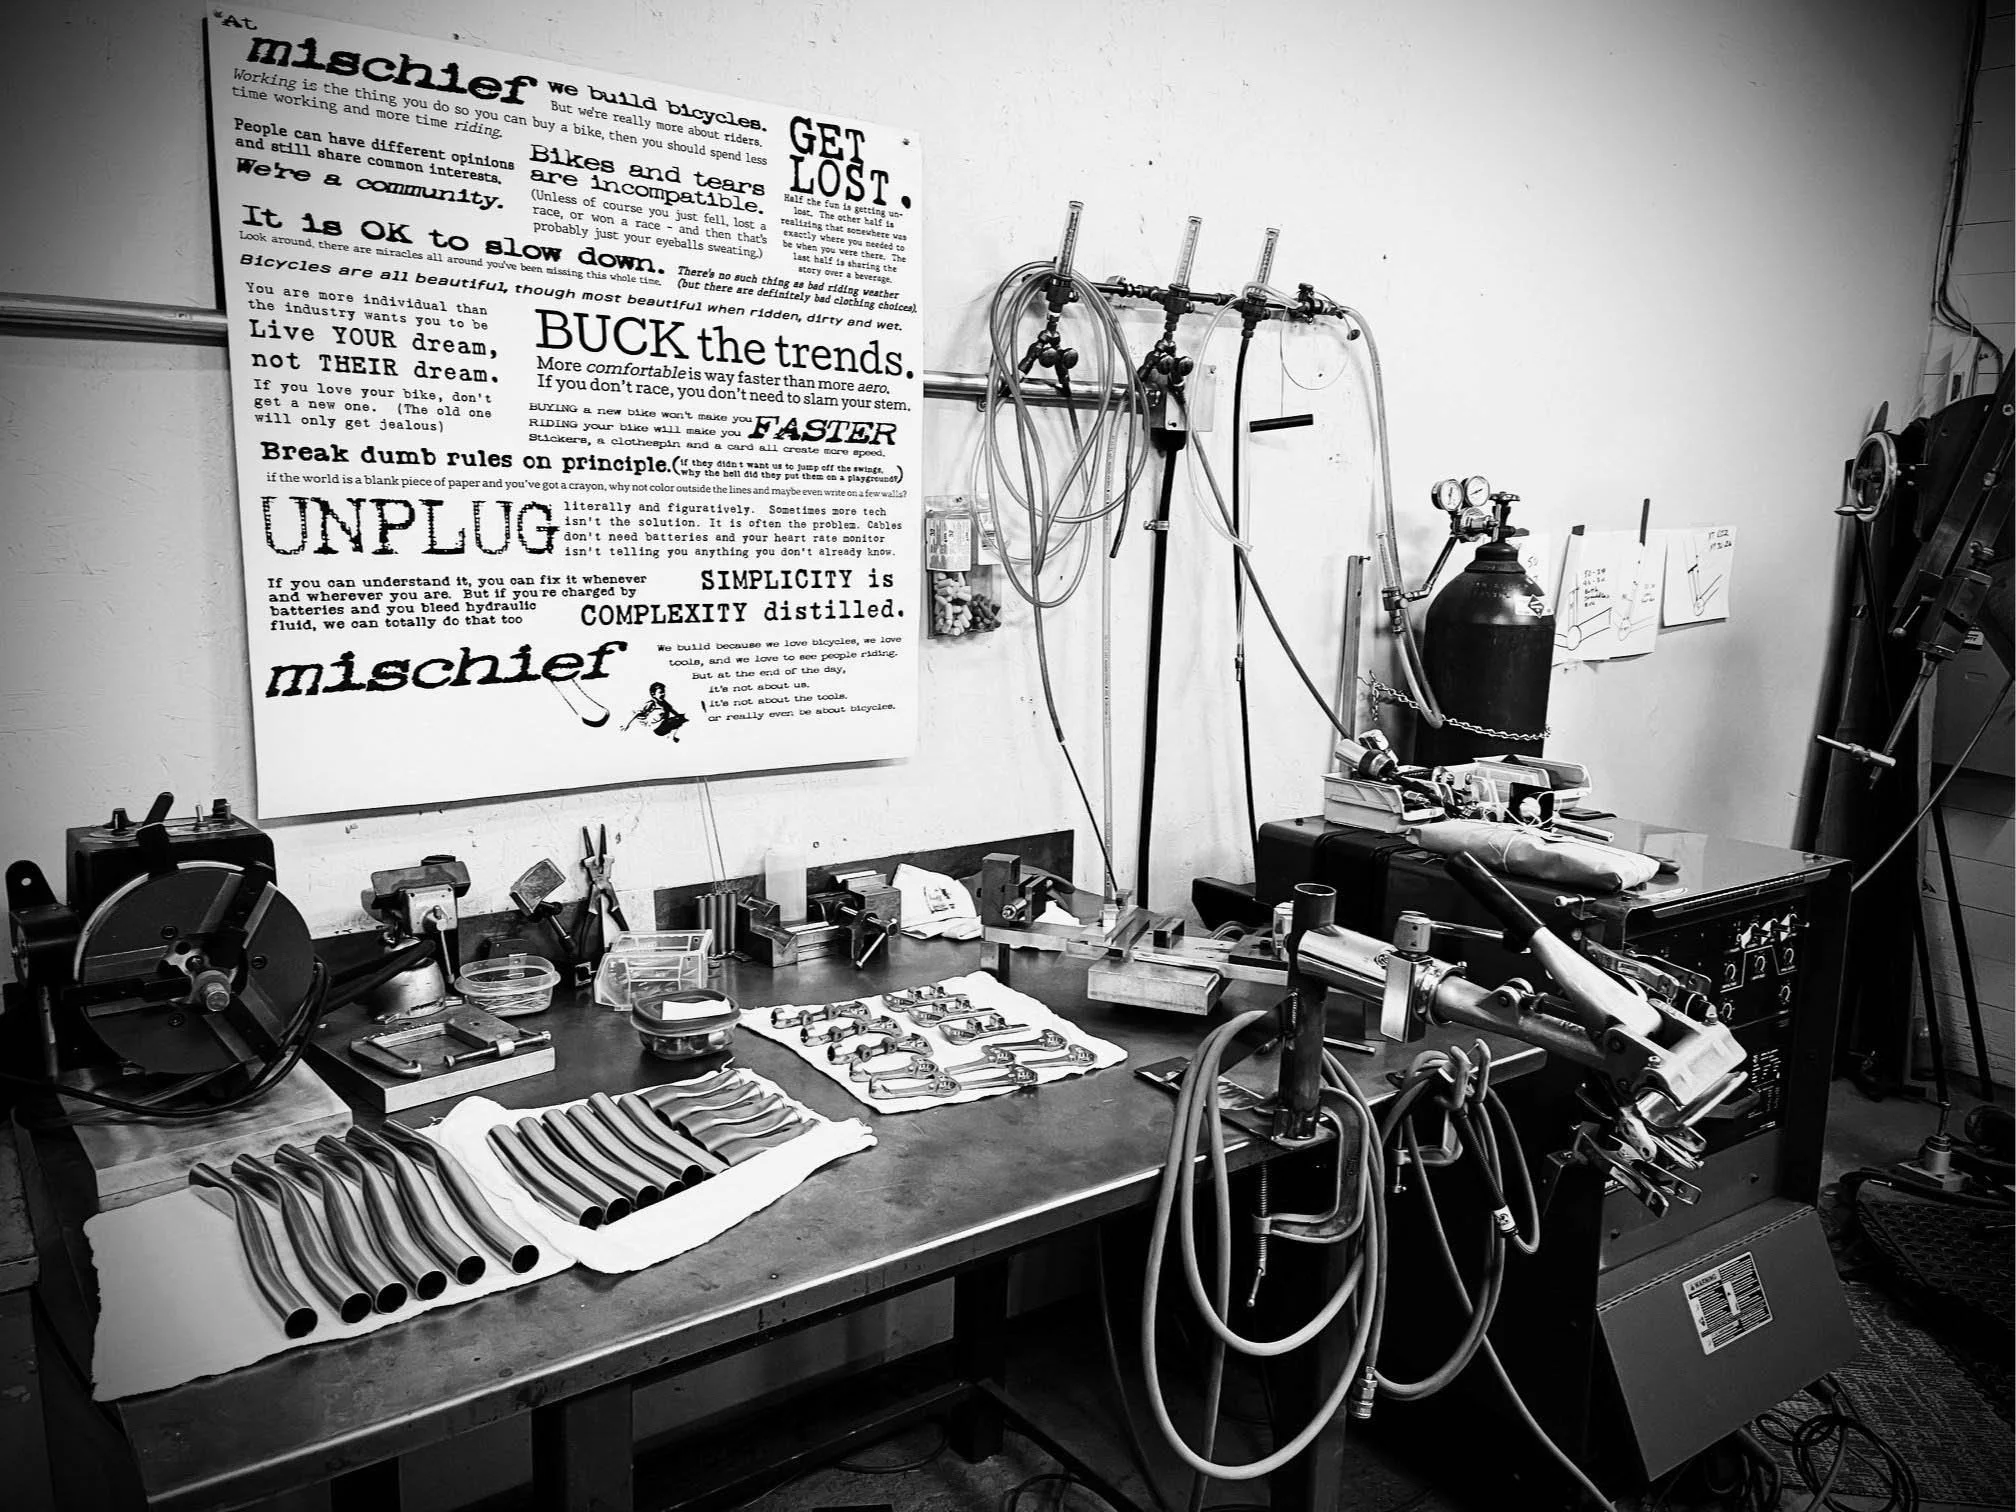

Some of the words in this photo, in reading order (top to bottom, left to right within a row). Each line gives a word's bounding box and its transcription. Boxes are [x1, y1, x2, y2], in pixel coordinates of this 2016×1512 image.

[213, 9, 259, 32] "At
[247, 36, 540, 106] mischief
[547, 81, 578, 96] we
[587, 85, 658, 111] build
[666, 100, 767, 132] bicycles.
[232, 86, 268, 100] time
[274, 94, 338, 114] working
[344, 104, 370, 115] and
[376, 110, 409, 122] more
[416, 114, 447, 128] time
[454, 121, 502, 139] riding.
[234, 68, 298, 91] Working
[302, 78, 317, 91] is
[324, 83, 348, 96] the
[355, 88, 397, 107] thing
[402, 98, 428, 108] you
[433, 100, 450, 112] do
[454, 106, 469, 115] so
[474, 110, 498, 120] you
[504, 115, 527, 125] can
[532, 116, 556, 132] buy
[560, 124, 568, 132] a
[573, 123, 604, 140] bike,
[609, 130, 637, 144] then
[642, 138, 663, 148] you
[667, 140, 706, 155] should
[710, 150, 742, 161] spend
[746, 153, 767, 165] less
[550, 100, 573, 114] But
[578, 107, 608, 119] we're
[612, 114, 651, 130] really
[656, 122, 683, 133] more
[688, 126, 720, 139] about
[724, 133, 762, 147] riders.
[234, 118, 288, 137] People
[294, 130, 322, 142] can
[328, 132, 366, 148] have
[371, 138, 446, 160] different
[452, 153, 514, 170] opinions
[235, 138, 264, 150] and
[271, 142, 311, 157] still
[317, 148, 362, 163] share
[367, 157, 424, 172] common
[429, 163, 502, 184] interests.
[789, 115, 866, 164] GET
[236, 158, 311, 182] We're
[323, 174, 342, 186] a
[356, 178, 503, 210] community.
[529, 144, 615, 173] Bikes
[629, 165, 681, 183] and
[693, 171, 765, 196] tears
[530, 170, 578, 186] are
[591, 175, 763, 214] incompatible.
[789, 154, 912, 210] LOST.
[784, 194, 804, 203] Half
[807, 198, 821, 206] the
[825, 200, 840, 209] fun
[843, 203, 851, 211] is
[854, 206, 886, 218] getting
[242, 205, 283, 228] It
[301, 213, 343, 236] is
[360, 220, 413, 244] OK
[428, 229, 469, 251] to
[485, 237, 562, 262] slow
[578, 247, 664, 274] down.
[240, 254, 332, 273] Bicycles
[338, 267, 373, 278] are
[380, 271, 408, 282] all
[415, 273, 508, 294] beautiful,
[515, 284, 576, 300] though
[582, 292, 622, 303] most
[627, 294, 702, 311] beautiful
[708, 304, 745, 315] when
[750, 308, 802, 322] ridden,
[806, 314, 843, 326] dirty
[847, 319, 872, 327] and
[877, 322, 902, 331] wet.
[678, 266, 715, 278] There's
[734, 274, 757, 283] such
[762, 276, 790, 289] thing
[808, 281, 824, 290] bad
[828, 284, 859, 297] riding
[863, 290, 900, 299] weather
[248, 319, 314, 341] Live
[332, 326, 397, 348] YOUR
[412, 333, 497, 359] dream,
[534, 309, 690, 359] BUCK
[697, 326, 766, 365] the
[774, 335, 914, 379] trends.
[251, 352, 300, 370] not
[319, 354, 398, 376] THEIR
[414, 361, 498, 383] dream.
[536, 356, 582, 372] More
[586, 362, 686, 379] comfortable
[688, 367, 702, 380] is
[704, 372, 735, 386] way
[738, 370, 781, 386] faster
[783, 374, 816, 388] than
[818, 380, 854, 391] more
[857, 384, 890, 394] aero.
[537, 374, 553, 388] If
[555, 379, 587, 392] you
[590, 378, 633, 393] don't
[636, 384, 674, 398] race,
[677, 387, 706, 400] you
[708, 386, 747, 400] don't
[749, 390, 784, 402] need
[787, 392, 801, 404] to
[803, 393, 838, 406] slam
[841, 398, 872, 410] your
[874, 399, 910, 411] stem.
[748, 414, 898, 447] FASTER
[260, 441, 349, 462] Break
[360, 446, 436, 465] dumb
[446, 450, 512, 468] rules
[522, 456, 552, 469] on
[562, 454, 671, 476] principle.
[261, 495, 561, 556] UNPLUG
[564, 501, 631, 514] literally
[639, 503, 660, 512] and
[668, 503, 754, 516] figuratively.
[769, 505, 826, 515] Sometimes
[864, 508, 886, 516] tech
[267, 578, 283, 588] If
[290, 580, 321, 591] you
[328, 580, 356, 588] can
[362, 576, 450, 587] understand
[456, 576, 472, 588] it,
[478, 578, 504, 588] you
[540, 575, 561, 584] fix
[566, 575, 577, 584] it
[582, 575, 647, 584] whenever
[701, 569, 852, 590] SIMPLICITY
[868, 568, 893, 588] is
[581, 602, 748, 626] COMPLEXITY
[764, 599, 904, 621] distilled.
[677, 643, 710, 651] build
[812, 638, 859, 647] bicycles,
[265, 640, 630, 699] mischief
